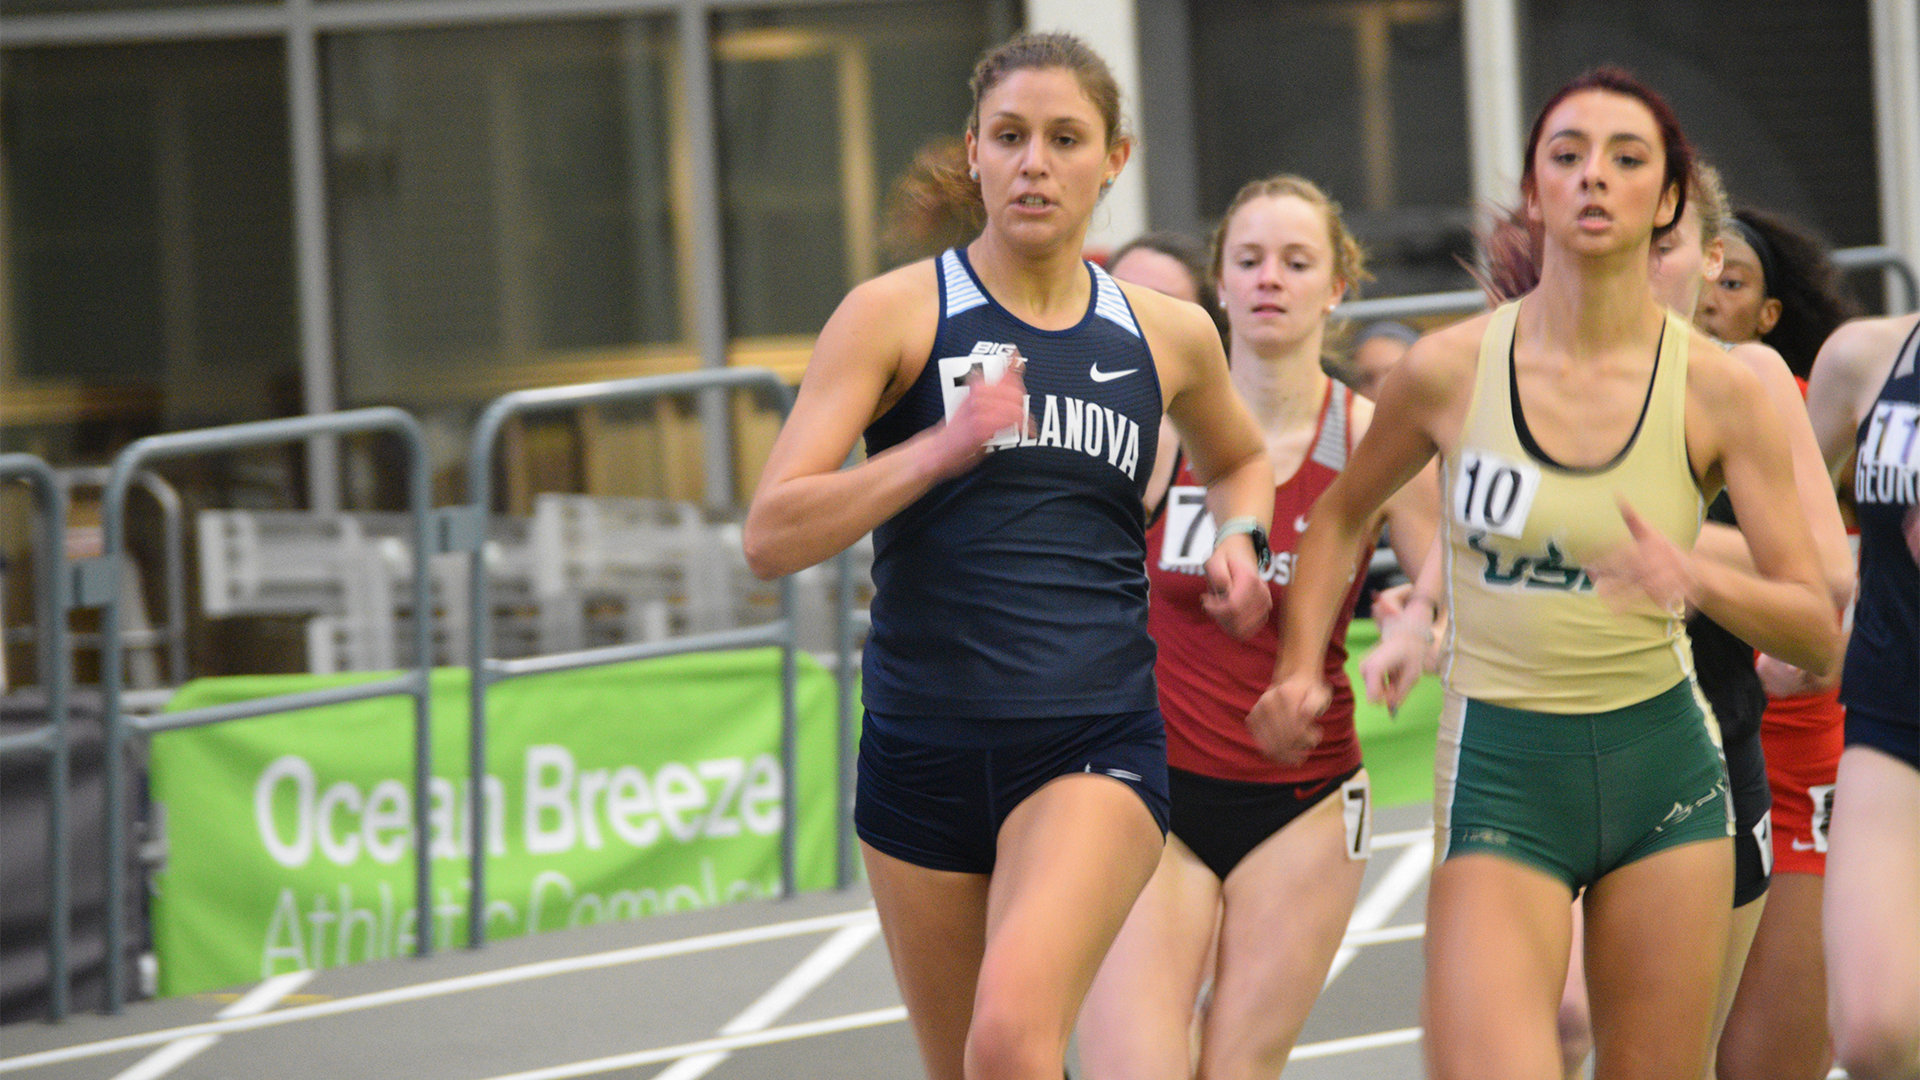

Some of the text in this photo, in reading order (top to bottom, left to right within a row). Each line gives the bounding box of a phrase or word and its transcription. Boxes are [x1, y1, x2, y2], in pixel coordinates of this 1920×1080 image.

[971, 340, 1018, 356] BIG
[981, 393, 1140, 482] LANOVA
[1464, 460, 1524, 528] 10
[1854, 440, 1920, 504] GEOR
[1178, 494, 1208, 558] 7
[255, 744, 784, 868] Ocean Breeze
[1347, 787, 1366, 853] 7
